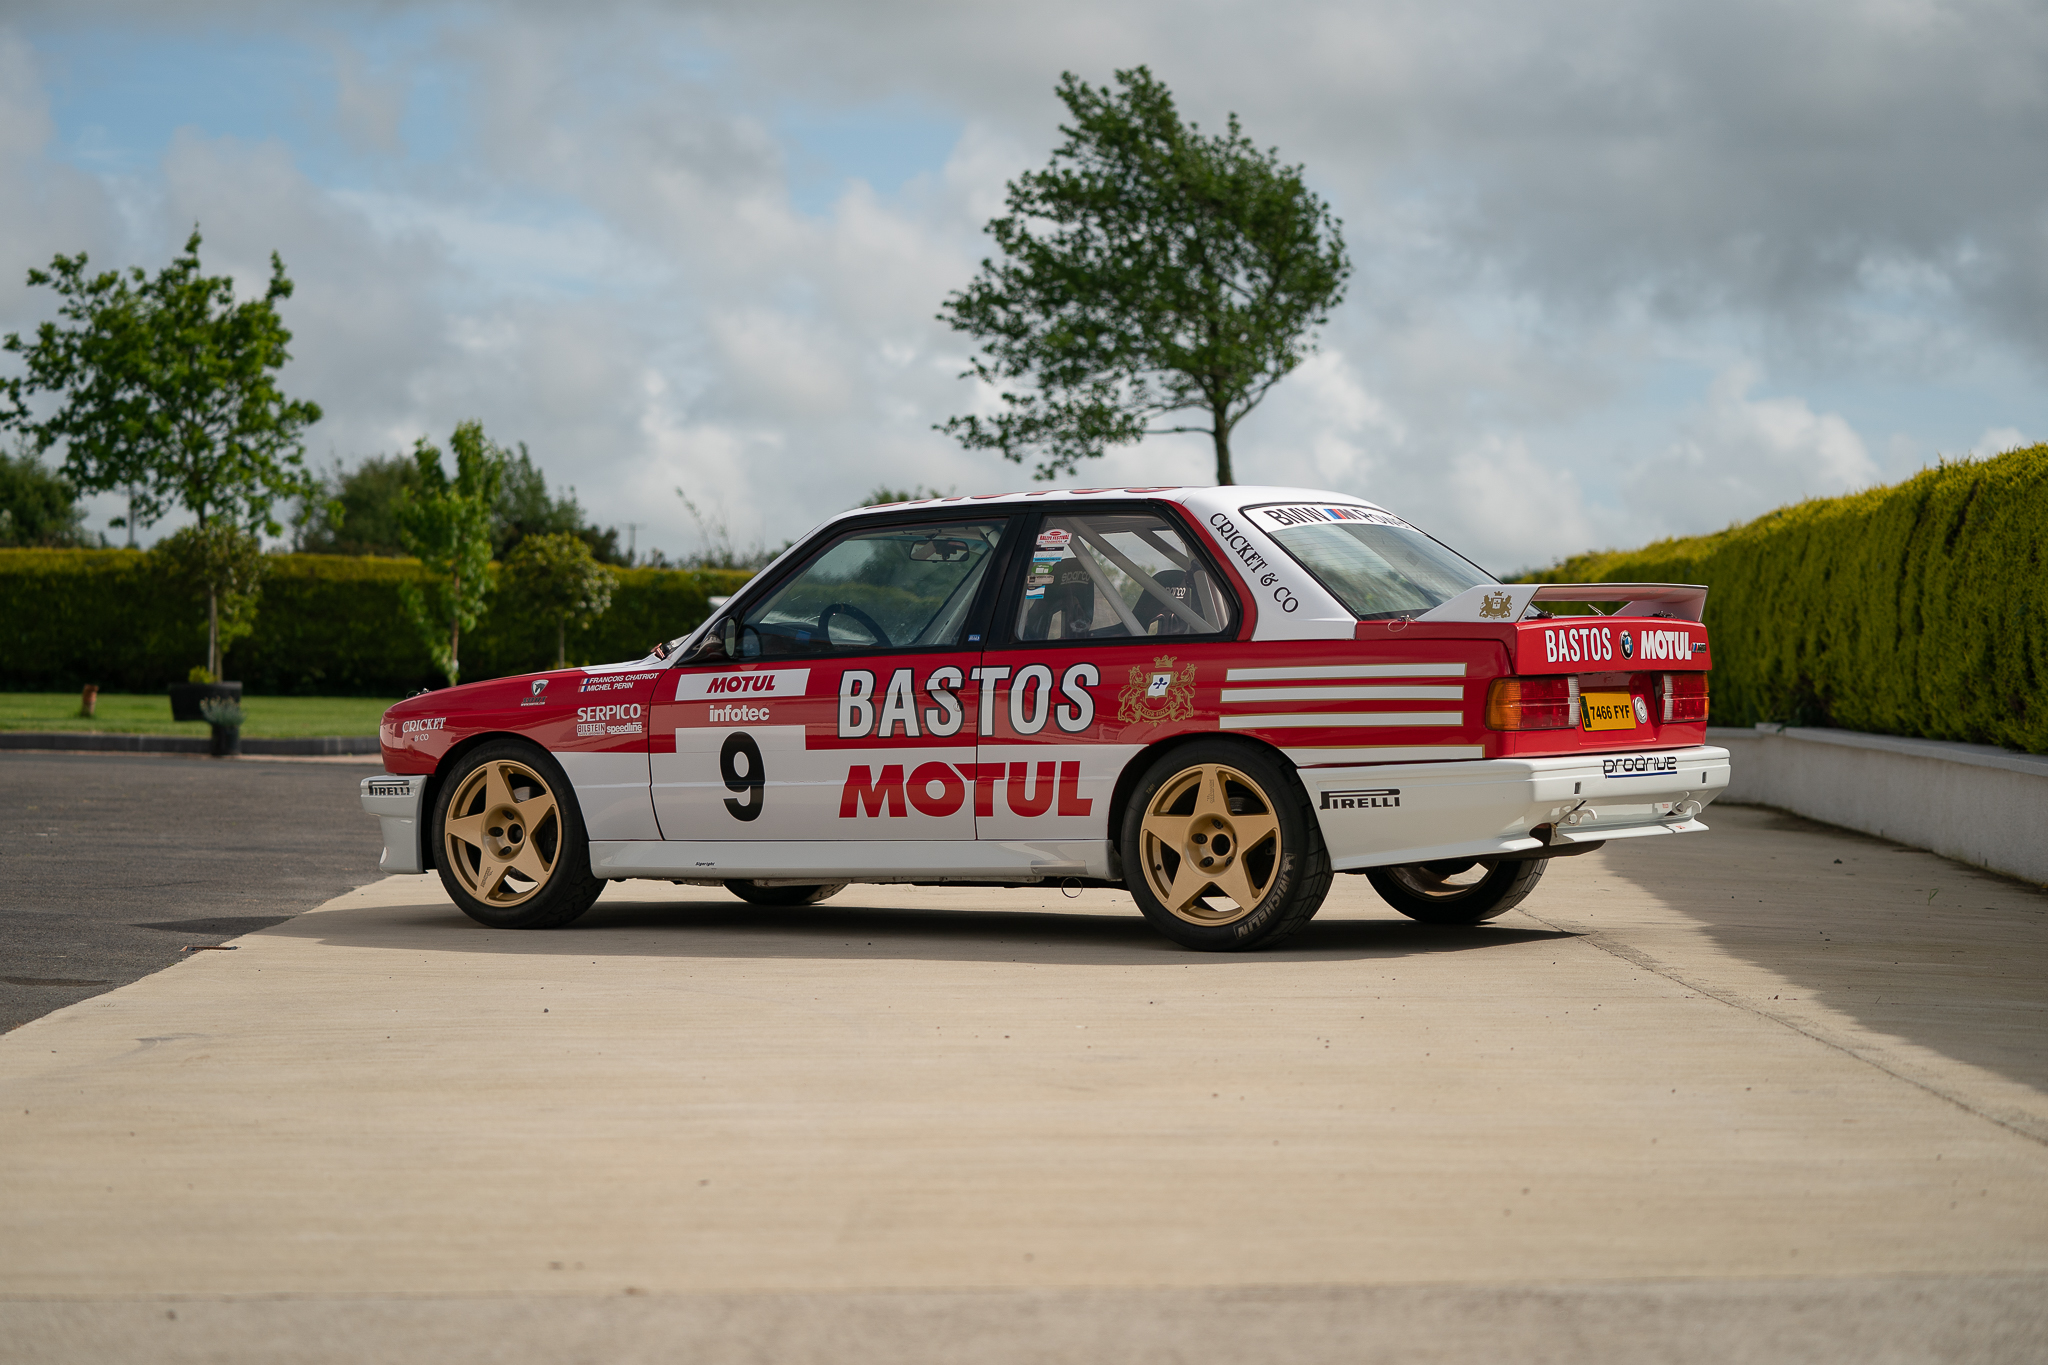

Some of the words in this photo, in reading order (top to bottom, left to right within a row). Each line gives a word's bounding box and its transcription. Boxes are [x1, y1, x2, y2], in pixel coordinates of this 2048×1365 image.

[1263, 507, 1331, 526] BMW
[1210, 513, 1268, 573] CRICKET
[1260, 572, 1279, 586] &
[1273, 587, 1299, 613] CO
[1061, 570, 1090, 583] sparco
[1544, 627, 1612, 662] BASTOS
[1640, 630, 1692, 660] MOTUL
[586, 683, 611, 692] MICHEL
[613, 682, 634, 690] PERIN
[588, 675, 624, 684] FRANCOIS
[625, 672, 659, 681] CHATRIOT
[706, 675, 775, 693] MOTUL
[838, 662, 1101, 739] BASTOS
[577, 703, 641, 722] SERPICO
[709, 704, 770, 722] infotec
[1589, 705, 1612, 720] 7466
[1613, 705, 1630, 719] FYF
[402, 717, 446, 733] CRICKET
[577, 724, 606, 733] BILSTEIN
[606, 722, 642, 734] speedline
[719, 731, 766, 822] 9
[1603, 755, 1677, 779] prodrive
[368, 780, 410, 796] PIRELLI
[838, 760, 1094, 818] MOTUL
[1319, 788, 1401, 810] PIRELLI
[1238, 874, 1290, 938] MICHELIN
